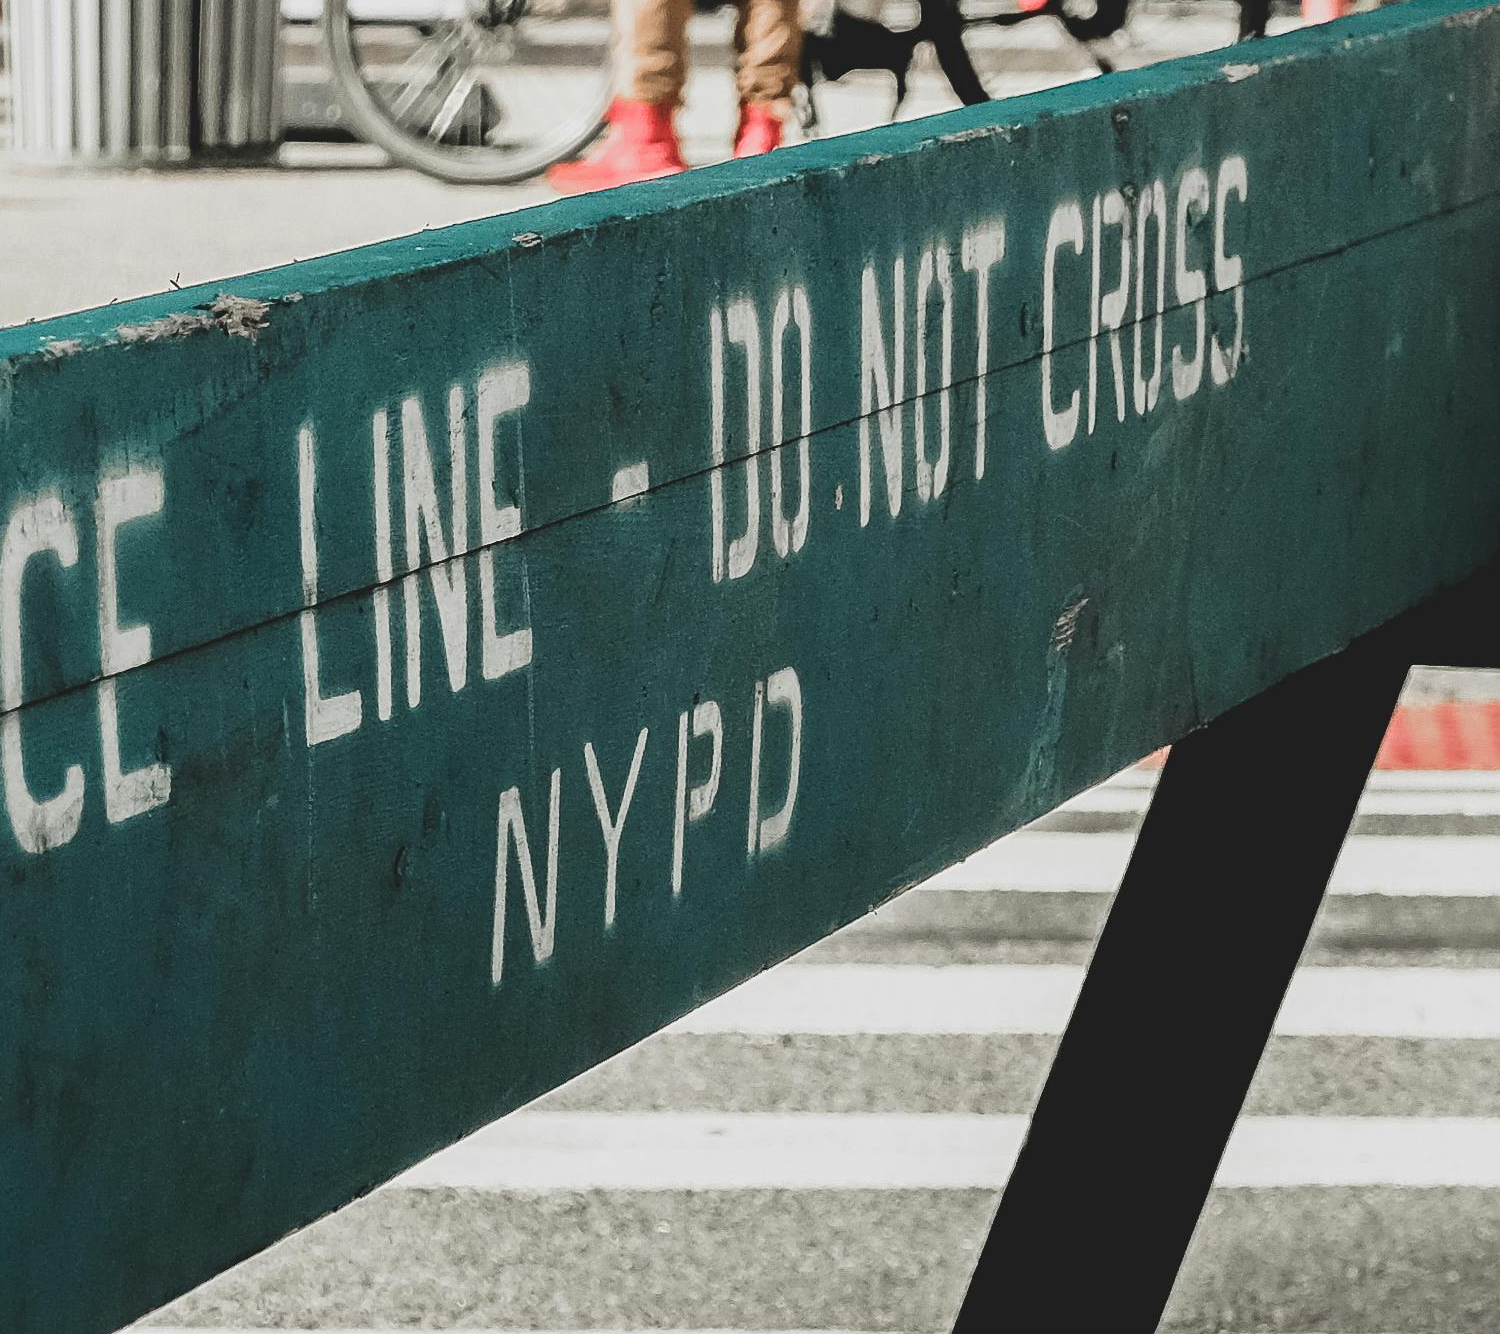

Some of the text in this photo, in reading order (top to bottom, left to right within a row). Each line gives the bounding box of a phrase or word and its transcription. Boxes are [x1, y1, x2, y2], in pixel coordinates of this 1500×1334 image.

[300, 360, 534, 744] LINE
[710, 286, 813, 584] DO
[859, 221, 1003, 527] NOT
[1040, 156, 1248, 452] CROSS
[493, 669, 803, 986] NYPD
